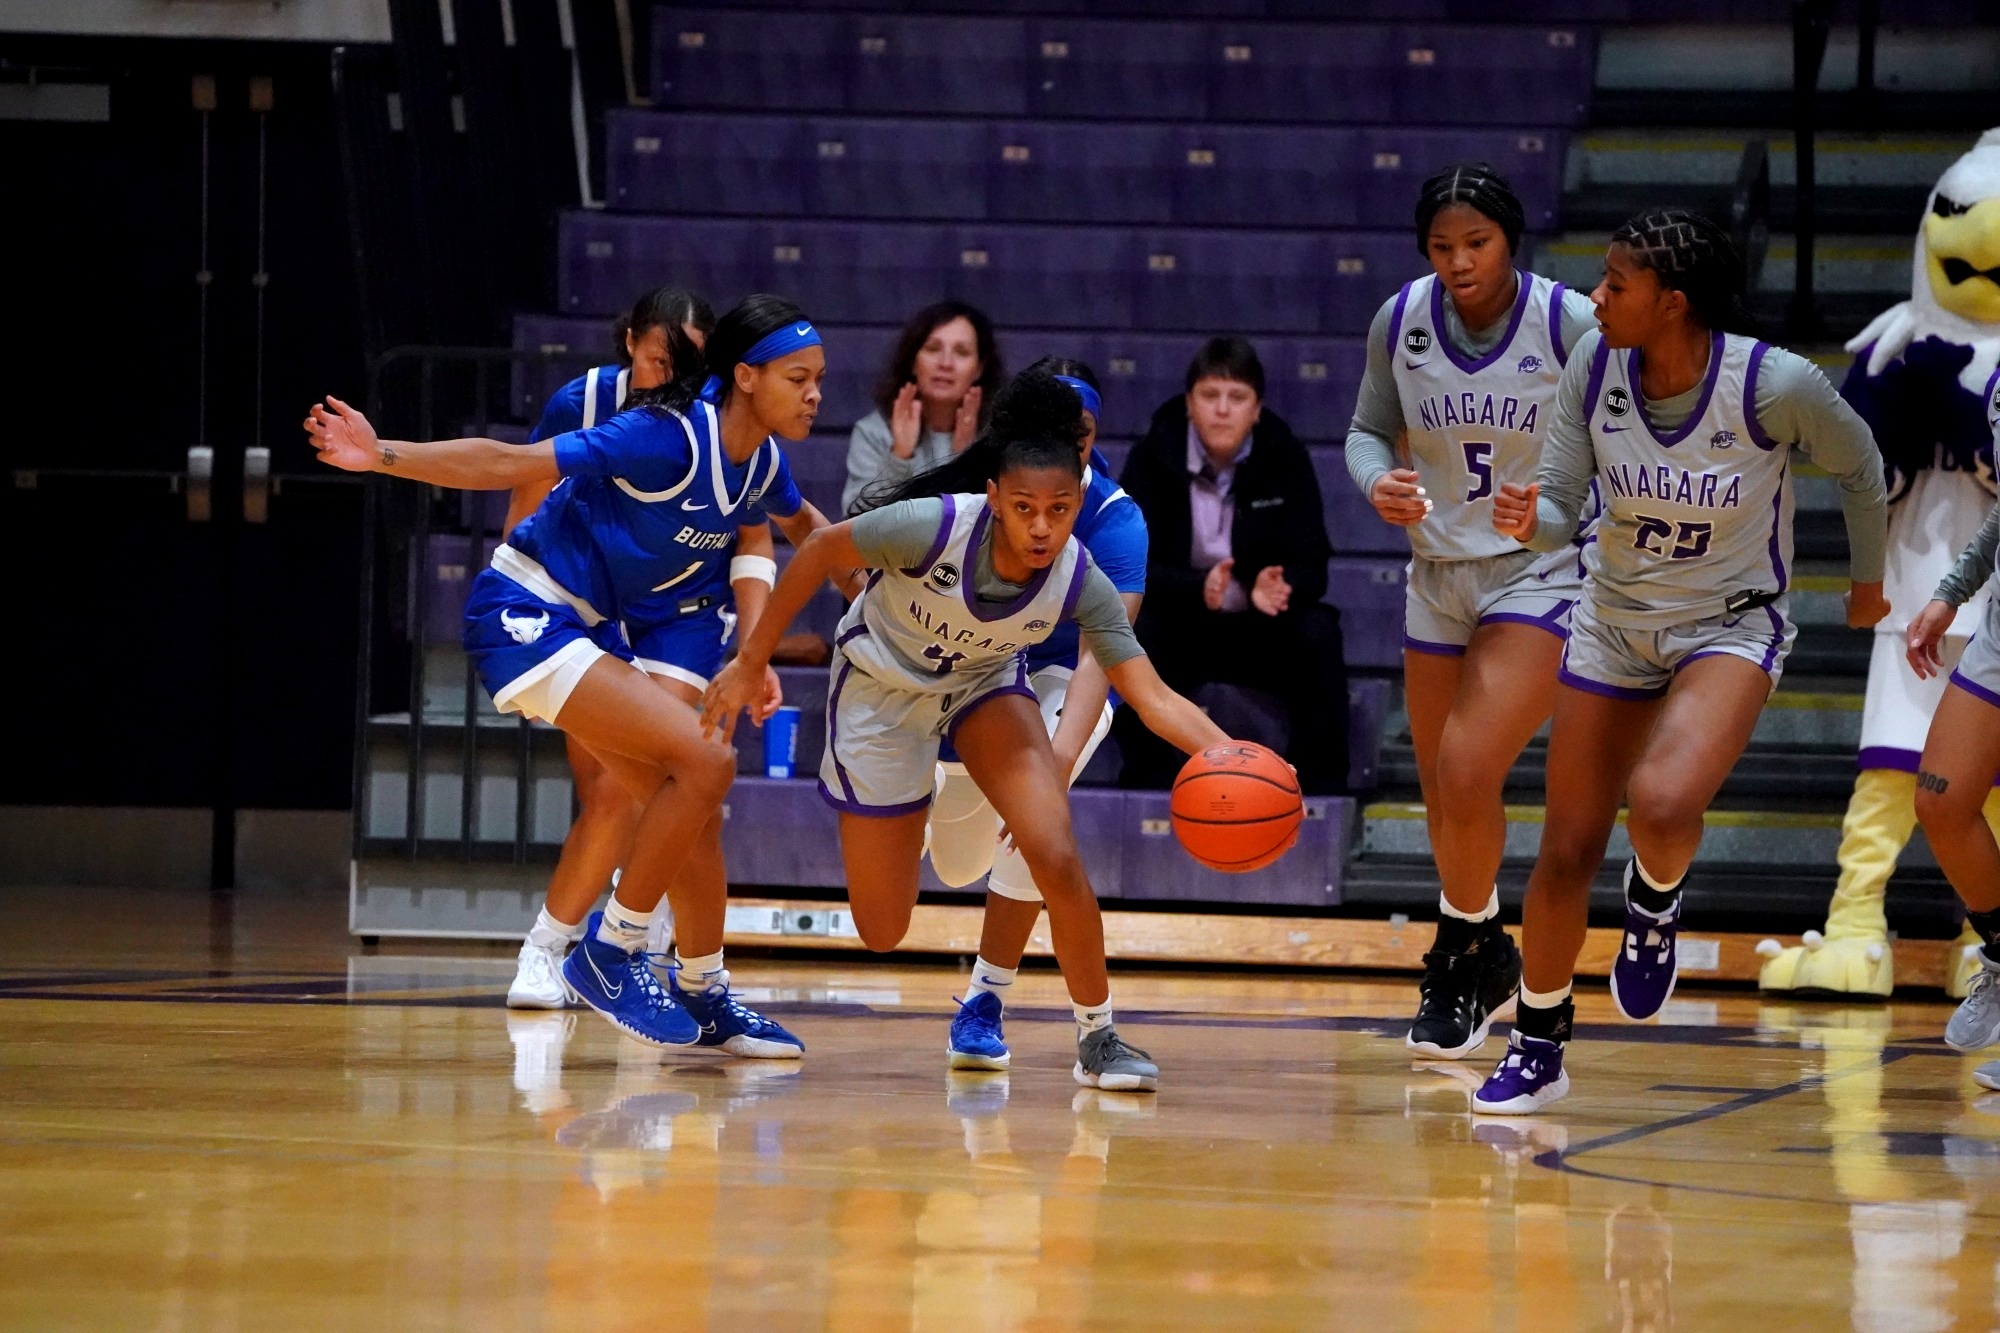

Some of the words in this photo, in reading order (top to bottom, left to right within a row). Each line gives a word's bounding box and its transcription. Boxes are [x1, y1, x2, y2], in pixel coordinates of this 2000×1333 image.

[1408, 335, 1428, 347] BLM
[1419, 392, 1539, 434] NIAGARA
[1607, 394, 1628, 409] BLM
[1460, 440, 1494, 504] 5
[1605, 464, 1741, 508] NIAGARA
[651, 560, 704, 592] 1
[934, 566, 957, 586] BLM
[908, 599, 1031, 657] NIAGAR
